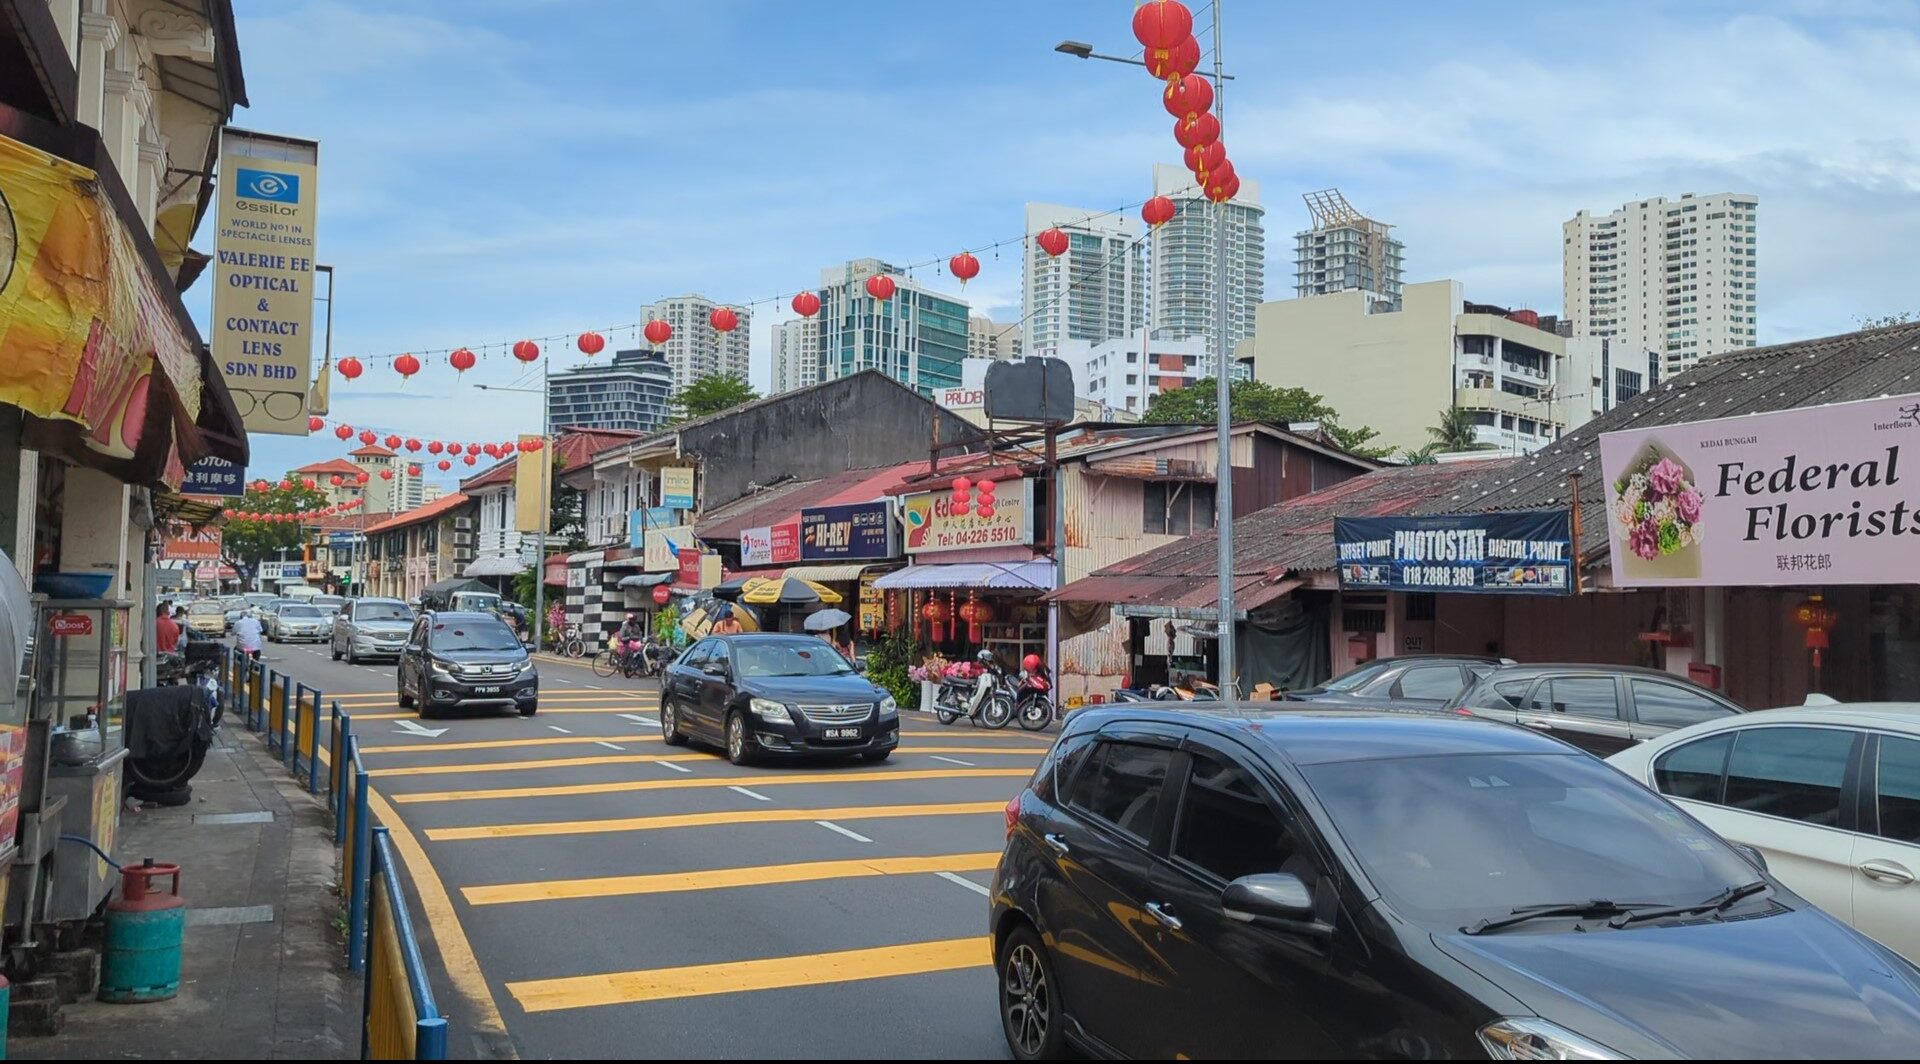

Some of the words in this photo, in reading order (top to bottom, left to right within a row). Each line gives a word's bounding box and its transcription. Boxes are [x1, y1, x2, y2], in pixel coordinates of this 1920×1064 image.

[235, 200, 298, 216] essilor
[231, 218, 267, 230] WORLD
[291, 226, 302, 234] IN
[221, 229, 277, 243] SPECTACLE
[279, 236, 312, 247] LENSES
[218, 250, 285, 270] VALERIE
[290, 257, 310, 272] EE
[229, 273, 299, 293] OPTICAL
[257, 297, 270, 312] &
[226, 317, 299, 336] CONTACT
[242, 340, 282, 357] LENS
[225, 361, 258, 377] SDN
[263, 364, 297, 380] BHD
[1873, 420, 1913, 431] Interflora
[1700, 440, 1723, 448] KEDAI
[1724, 436, 1758, 446] BUNGAH
[194, 456, 233, 468] OTOR
[1714, 445, 1900, 498] Federal
[1742, 500, 1920, 541] Florists
[815, 521, 852, 547] HI-REV
[937, 533, 954, 546] Tel:
[991, 526, 1016, 542] 5510
[750, 538, 768, 550] TOTAL
[1340, 542, 1365, 560] OFFSET
[1366, 539, 1392, 558] PRINT
[1394, 529, 1487, 561] PHOTOSTAT
[1488, 538, 1528, 559] DIGITAL
[1529, 541, 1564, 561] PRINT
[1776, 553, 1832, 571] 联邦花郎
[1403, 566, 1421, 585] 018
[1423, 566, 1450, 586] 2888
[1452, 566, 1475, 586] 389
[1405, 636, 1423, 647] OUT
[825, 729, 839, 738] WSA
